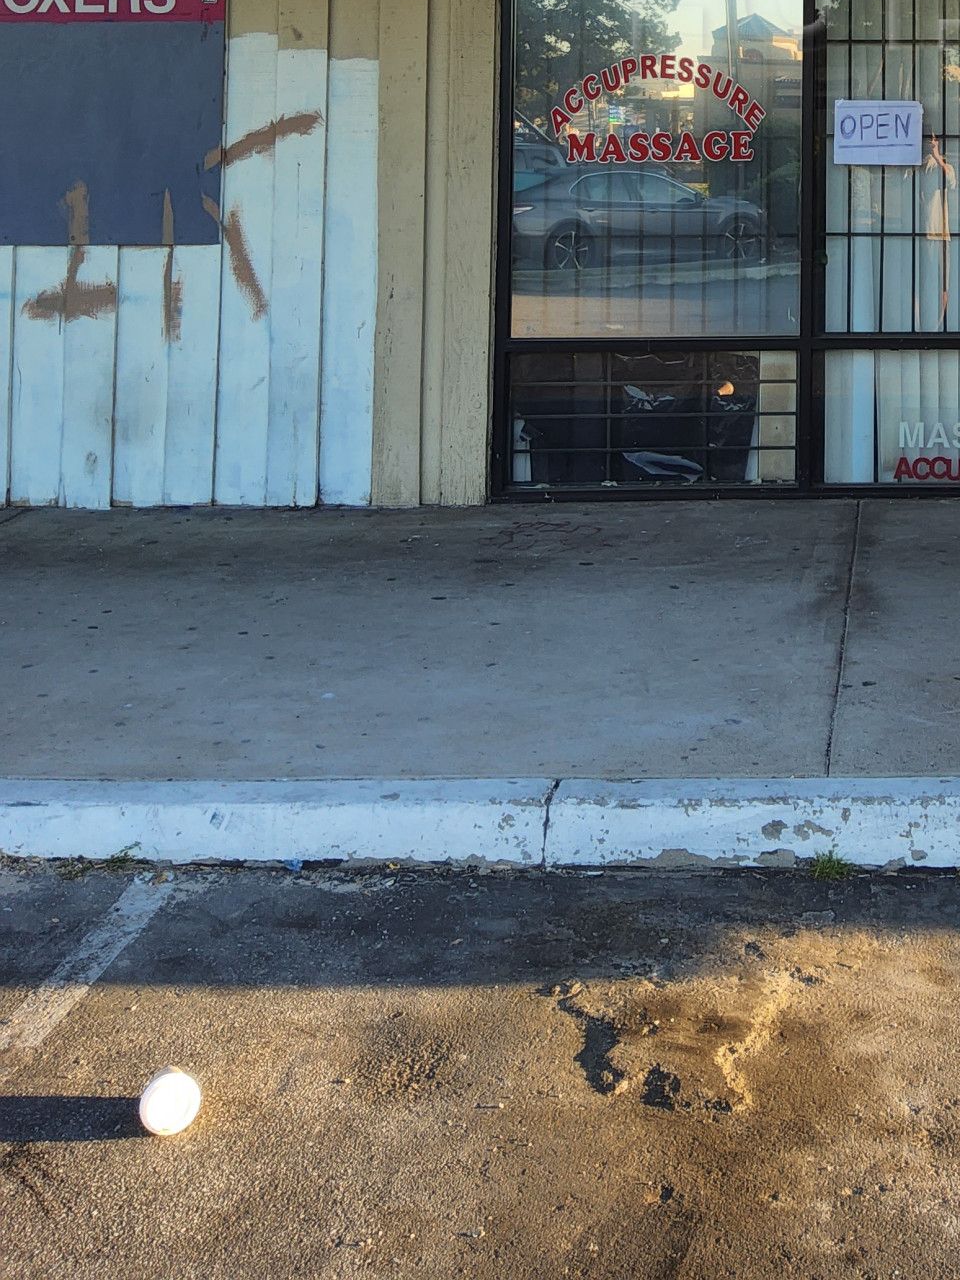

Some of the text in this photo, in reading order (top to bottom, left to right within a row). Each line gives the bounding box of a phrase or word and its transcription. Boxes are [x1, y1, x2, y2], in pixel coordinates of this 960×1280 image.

[551, 53, 767, 137] ACCUPRESSURE
[840, 112, 912, 141] OPEN
[566, 130, 755, 164] MASSAGE
